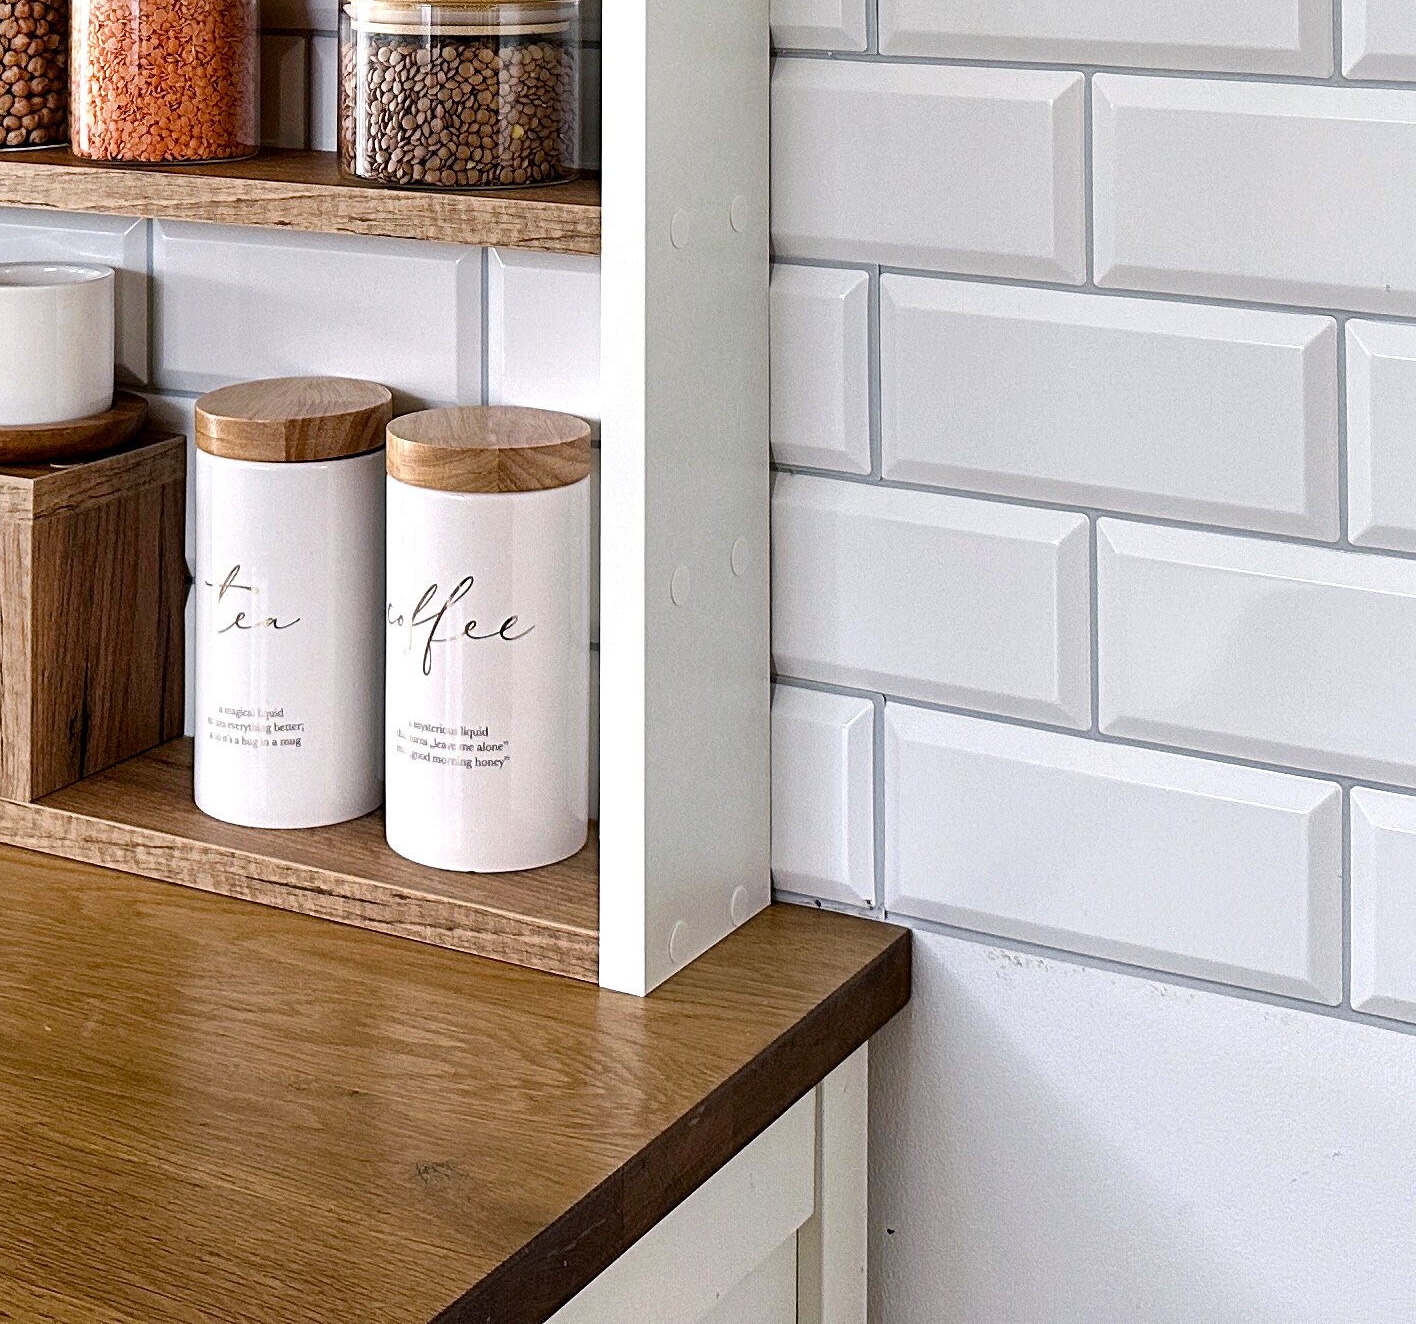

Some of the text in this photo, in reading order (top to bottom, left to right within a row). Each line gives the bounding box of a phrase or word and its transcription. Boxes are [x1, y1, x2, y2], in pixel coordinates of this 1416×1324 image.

[204, 564, 301, 634] tea
[387, 575, 536, 677] coffee
[459, 743, 475, 753] me
[460, 725, 489, 739] liquid
